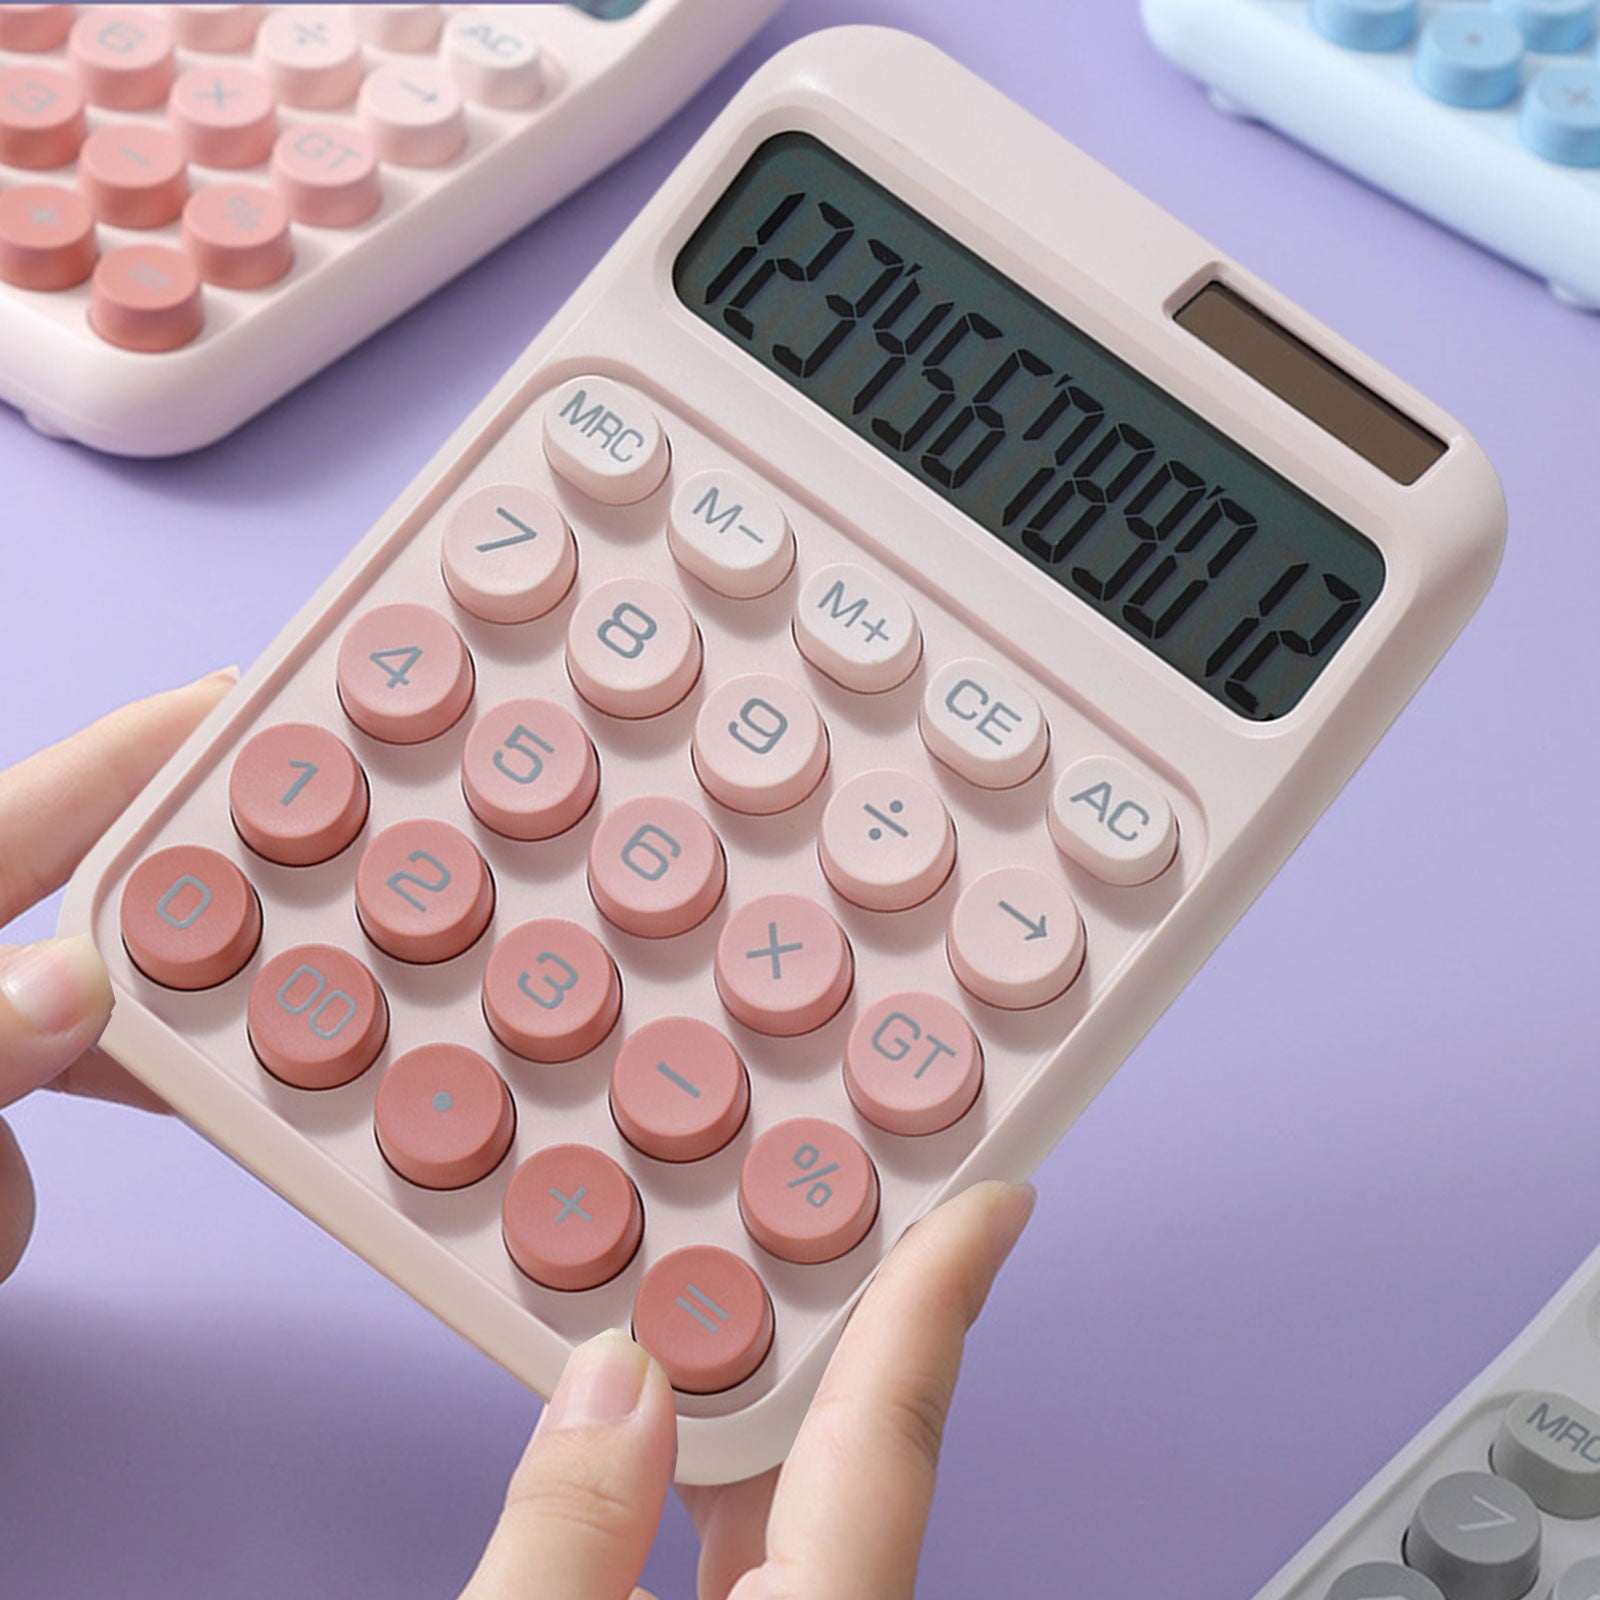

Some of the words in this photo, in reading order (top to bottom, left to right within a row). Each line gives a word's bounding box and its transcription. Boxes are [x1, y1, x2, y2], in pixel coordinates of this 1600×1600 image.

[294, 131, 363, 169] GT
[559, 389, 644, 464] MRC
[475, 507, 537, 553] 7
[597, 602, 658, 660] 8
[817, 580, 890, 645] M+
[369, 645, 424, 689] 4
[728, 698, 789, 755] 9
[945, 678, 1023, 747] CE
[279, 759, 319, 807] 1
[492, 724, 556, 785] 5
[1070, 781, 1151, 842] AC
[386, 850, 452, 913] 2
[620, 823, 682, 882] 6
[156, 875, 213, 931] 0
[276, 964, 358, 1040] 00
[517, 951, 580, 1010] 3
[871, 1011, 957, 1080] GT
